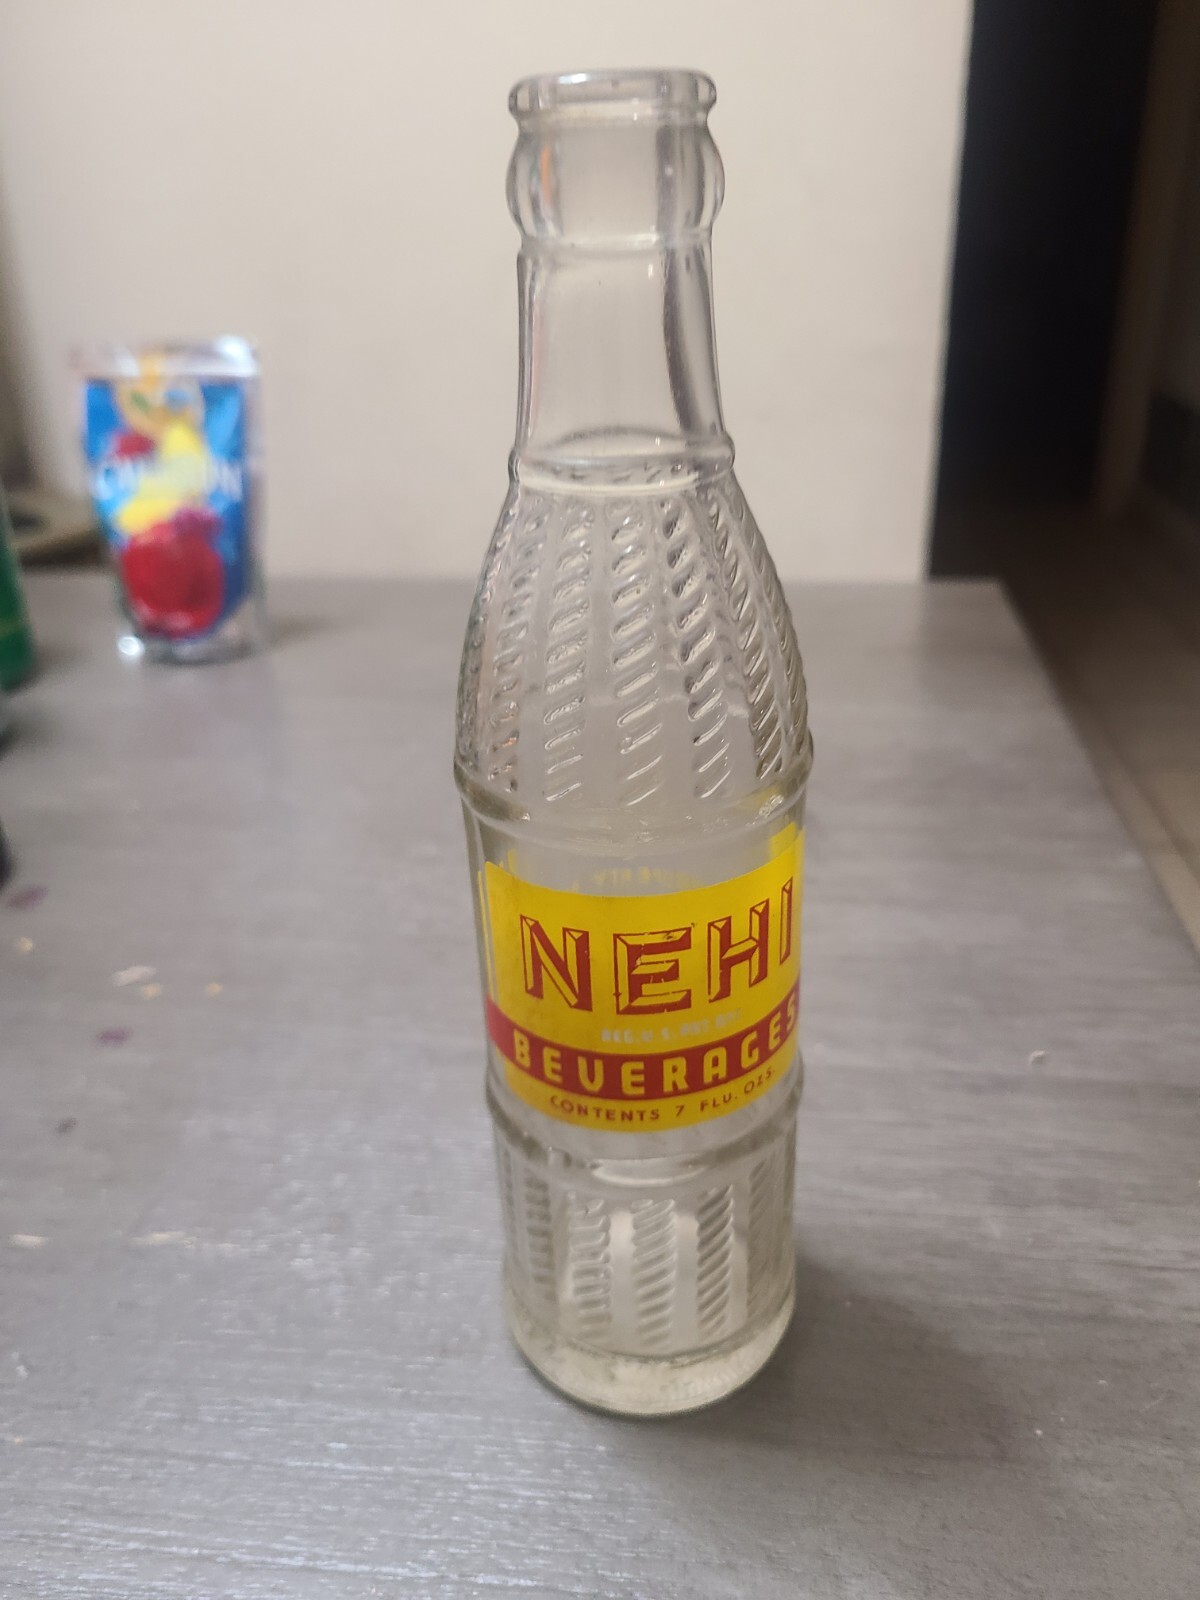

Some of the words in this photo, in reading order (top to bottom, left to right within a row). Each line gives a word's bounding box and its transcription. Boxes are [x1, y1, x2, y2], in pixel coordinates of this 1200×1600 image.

[519, 876, 794, 1015] NEHI
[513, 989, 799, 1097] BEVERAGES
[550, 1095, 660, 1121] CONTENTS
[675, 1104, 686, 1118] 7
